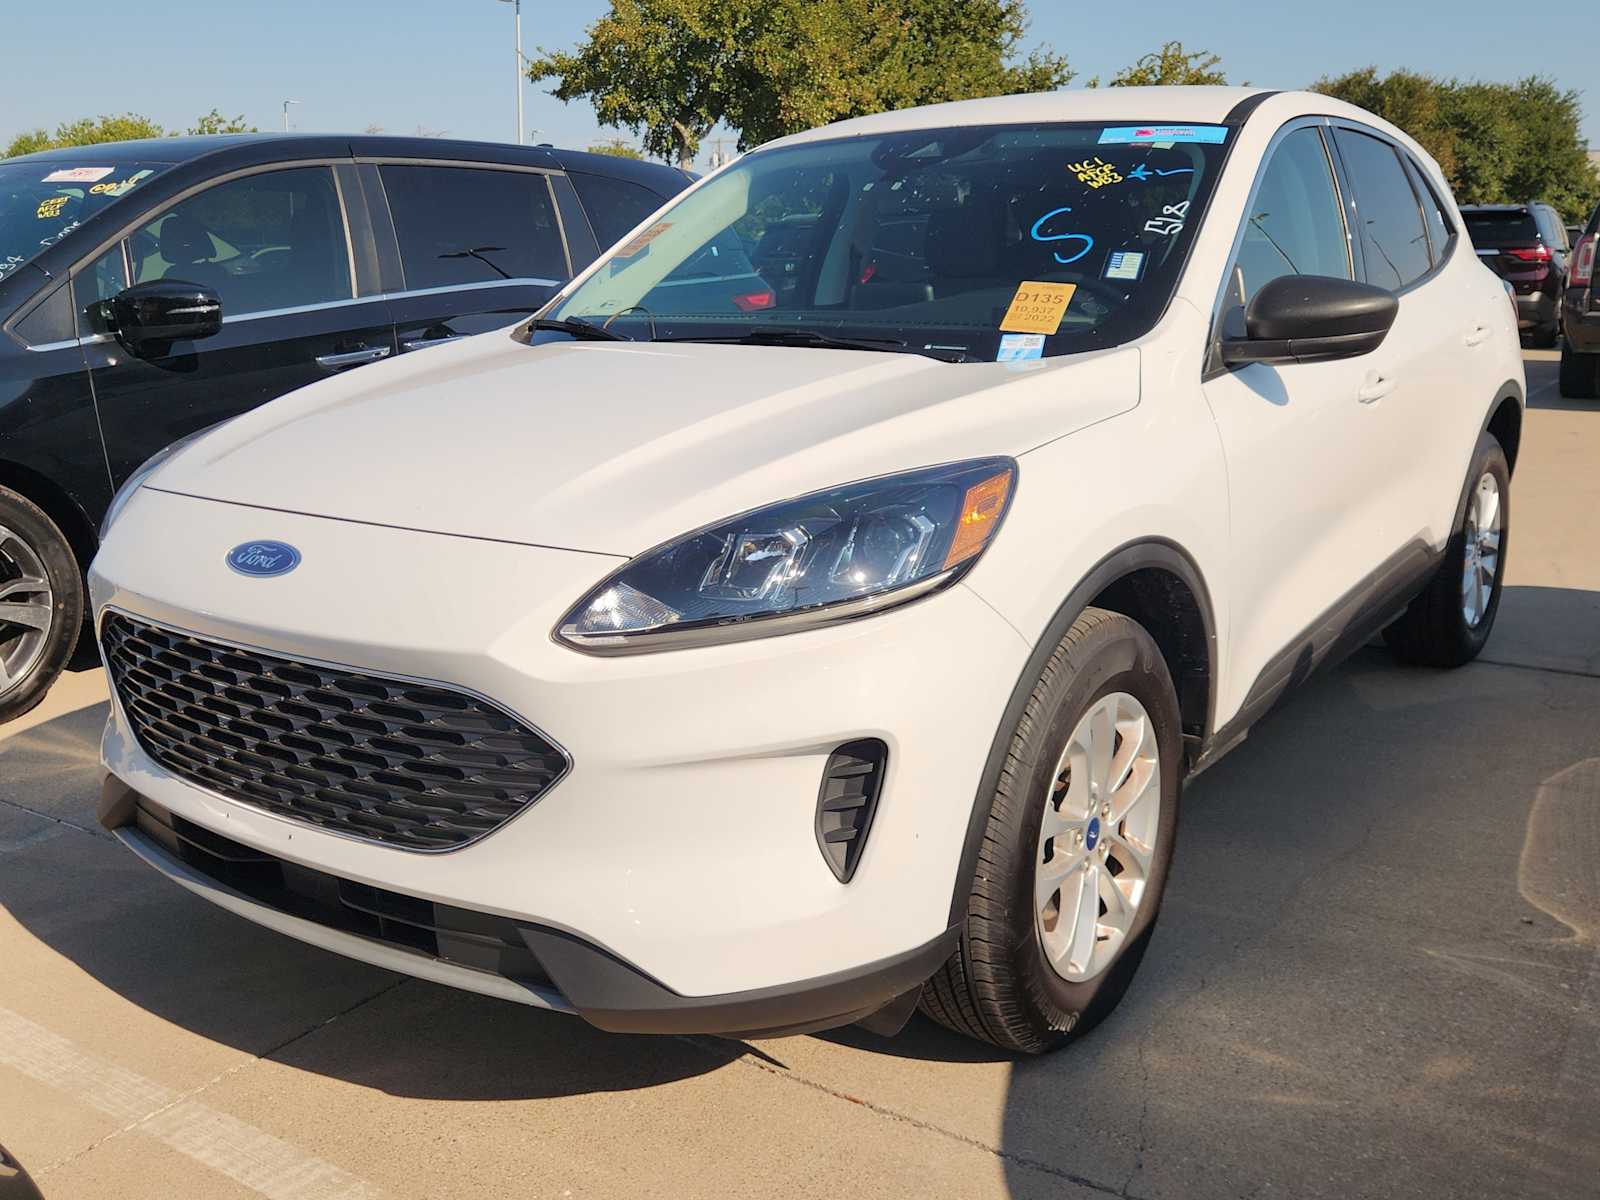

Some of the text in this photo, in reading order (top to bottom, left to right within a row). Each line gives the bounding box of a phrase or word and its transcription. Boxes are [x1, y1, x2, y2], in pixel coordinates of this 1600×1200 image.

[1031, 207, 1094, 264] S
[1015, 292, 1065, 305] D135
[236, 544, 283, 569] Ford
